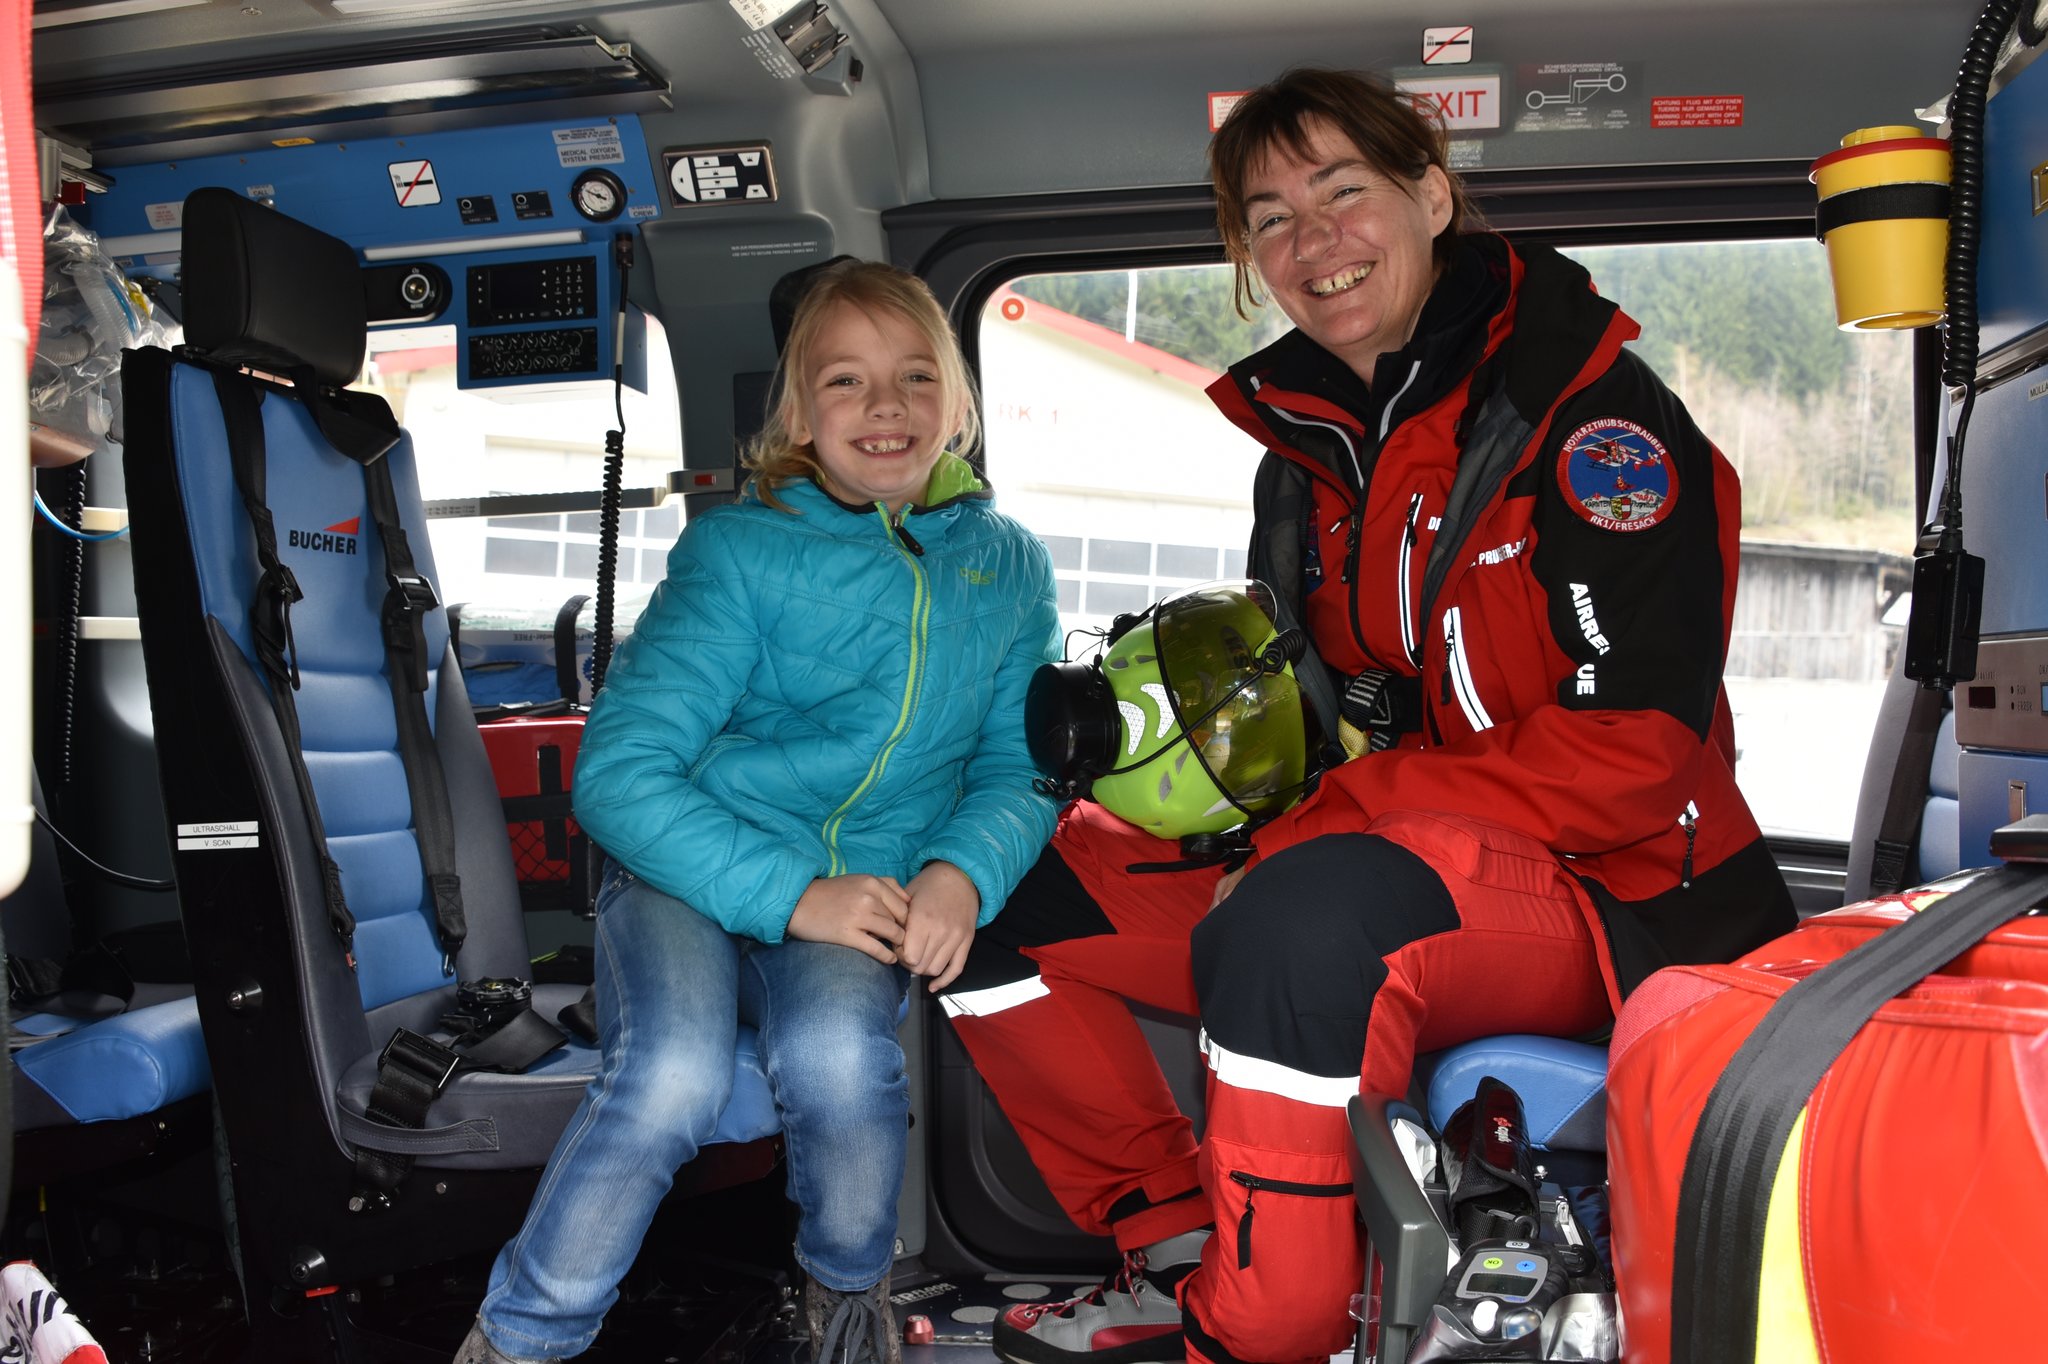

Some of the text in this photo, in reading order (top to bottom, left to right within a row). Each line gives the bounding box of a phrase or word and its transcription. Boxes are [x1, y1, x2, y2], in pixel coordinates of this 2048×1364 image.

[1412, 90, 1487, 118] EXIT
[562, 152, 622, 163] SYSTEM PRESSURE
[1563, 419, 1666, 455] NOTARZTHUBSCHRAUBER
[1590, 515, 1656, 530] RK1/FRESACH
[289, 530, 357, 555] BUCHER
[193, 824, 240, 833] ULTRASCHALL
